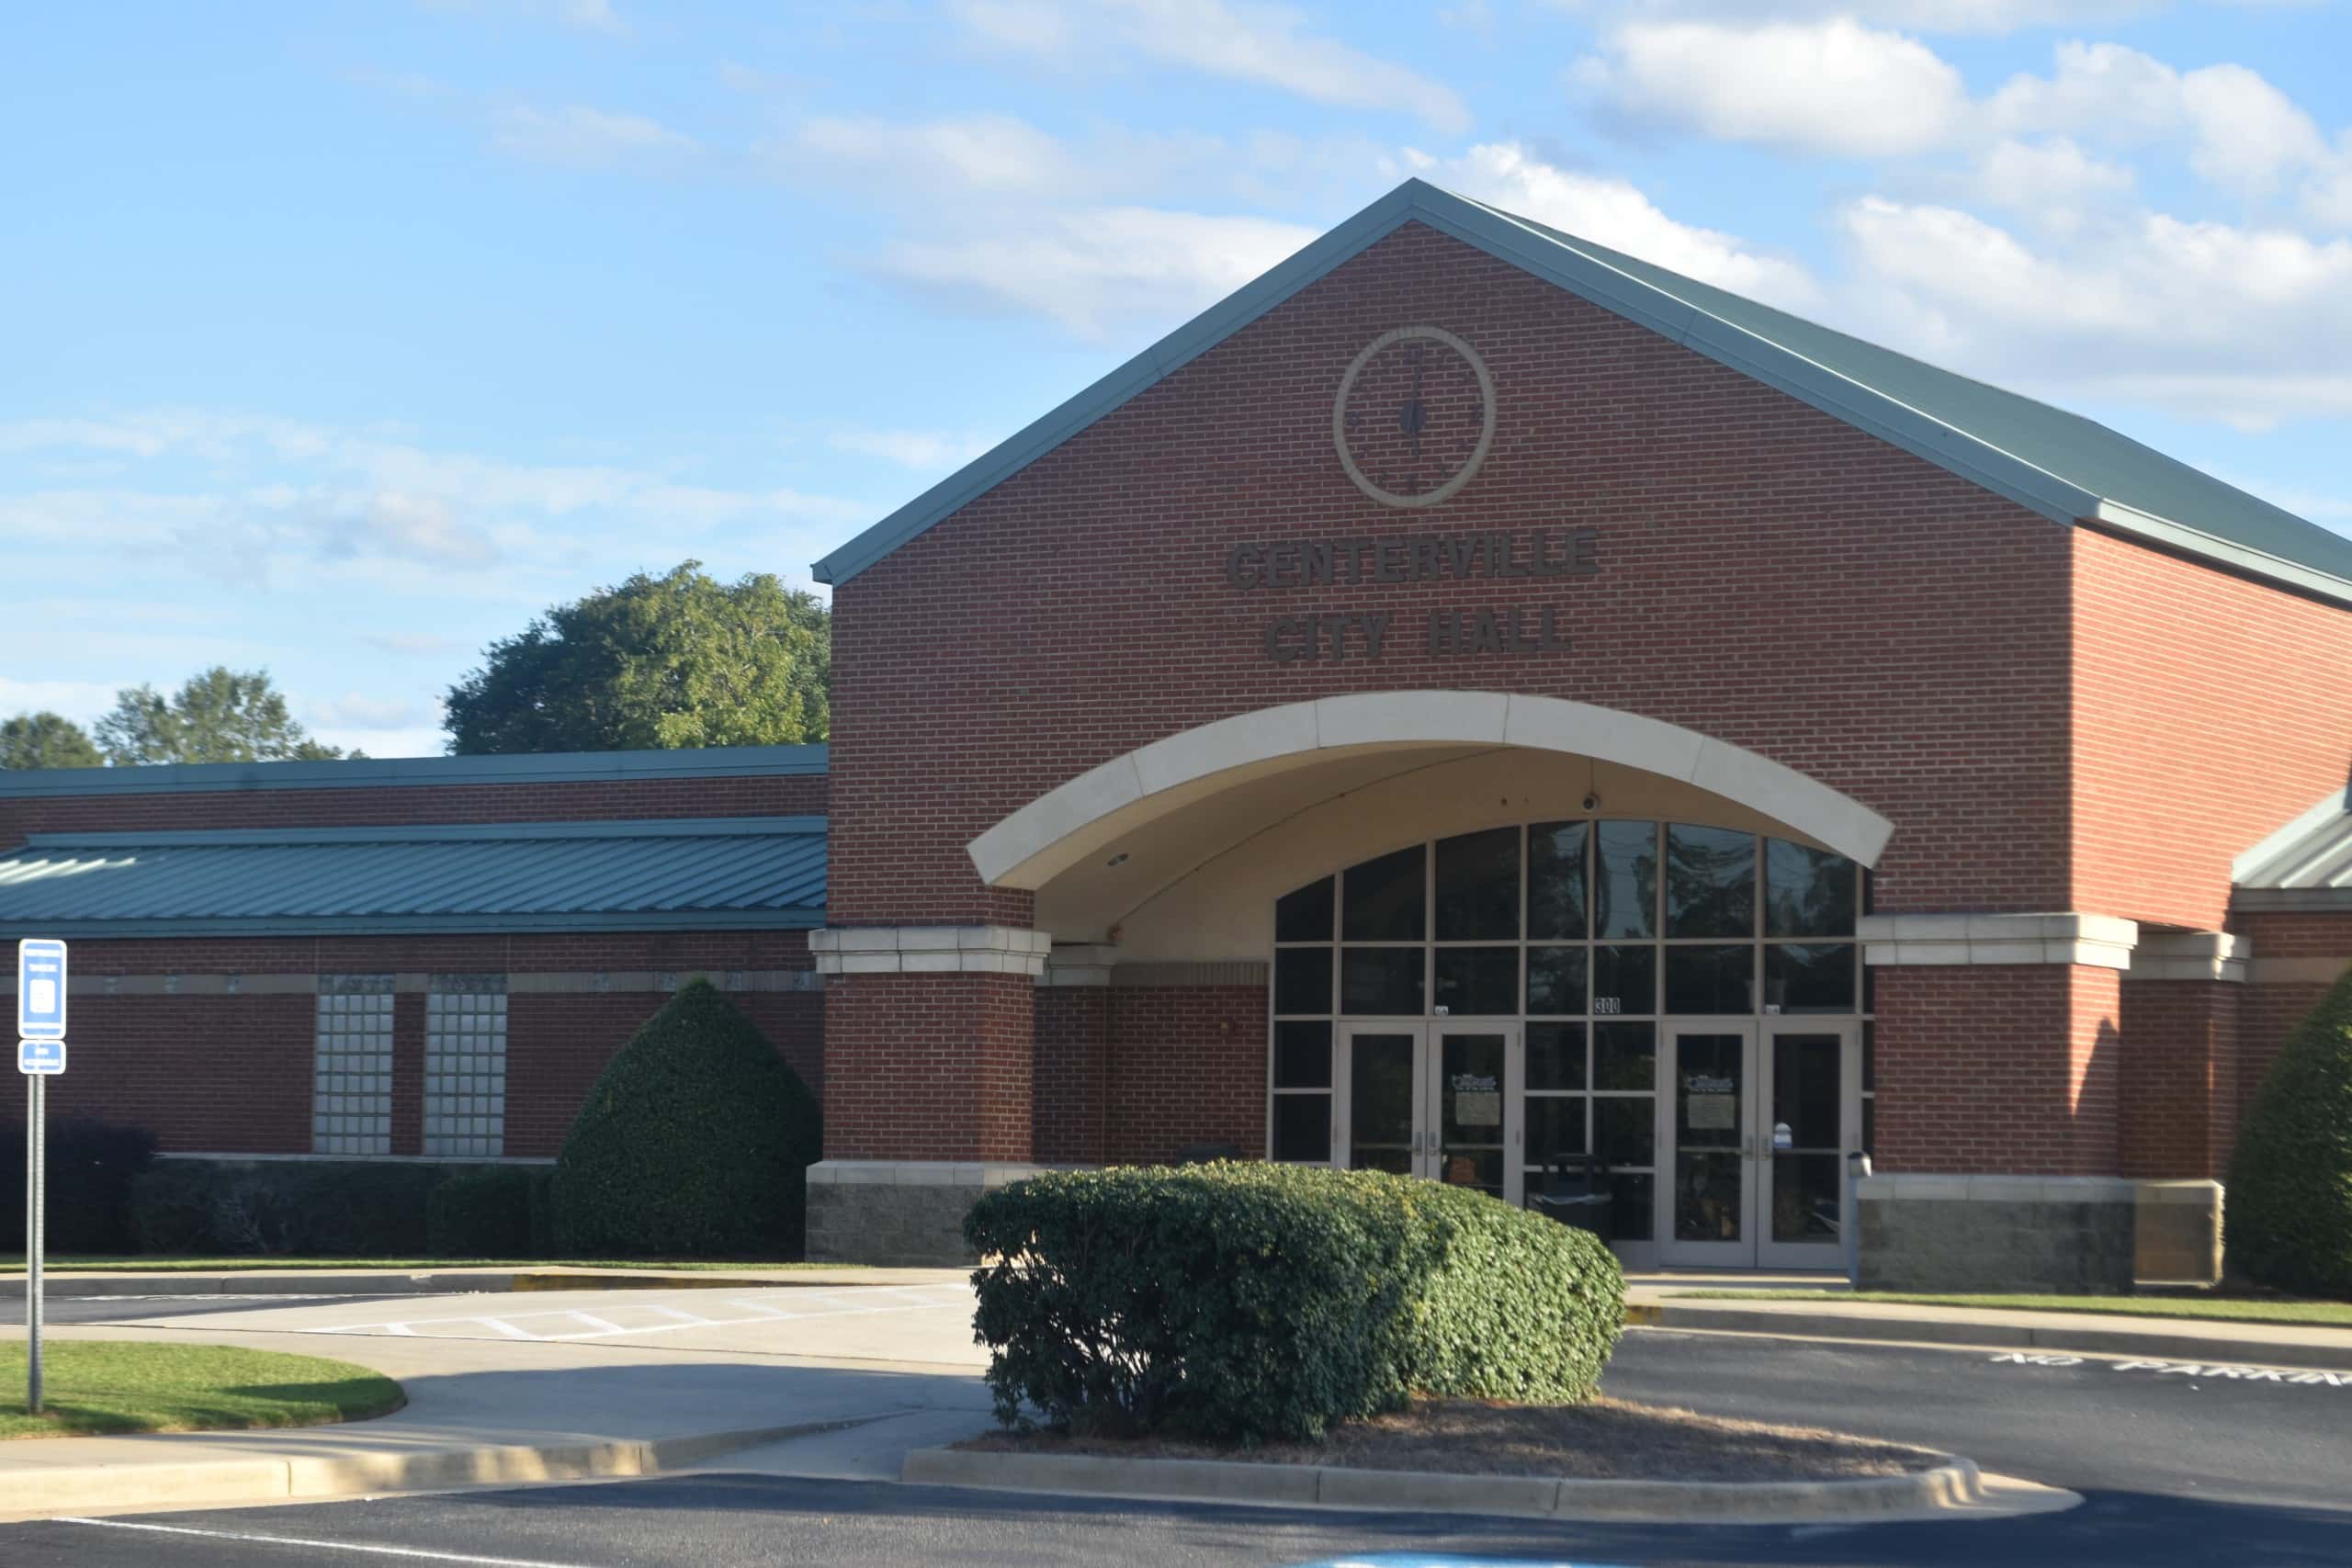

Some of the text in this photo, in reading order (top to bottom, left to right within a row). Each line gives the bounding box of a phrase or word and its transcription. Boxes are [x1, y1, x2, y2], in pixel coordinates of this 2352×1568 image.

[1227, 529, 1600, 589] CENTERVILLE
[1267, 605, 1571, 661] CITY HALL
[1595, 998, 1620, 1014] 300
[1988, 1353, 2084, 1366] NO
